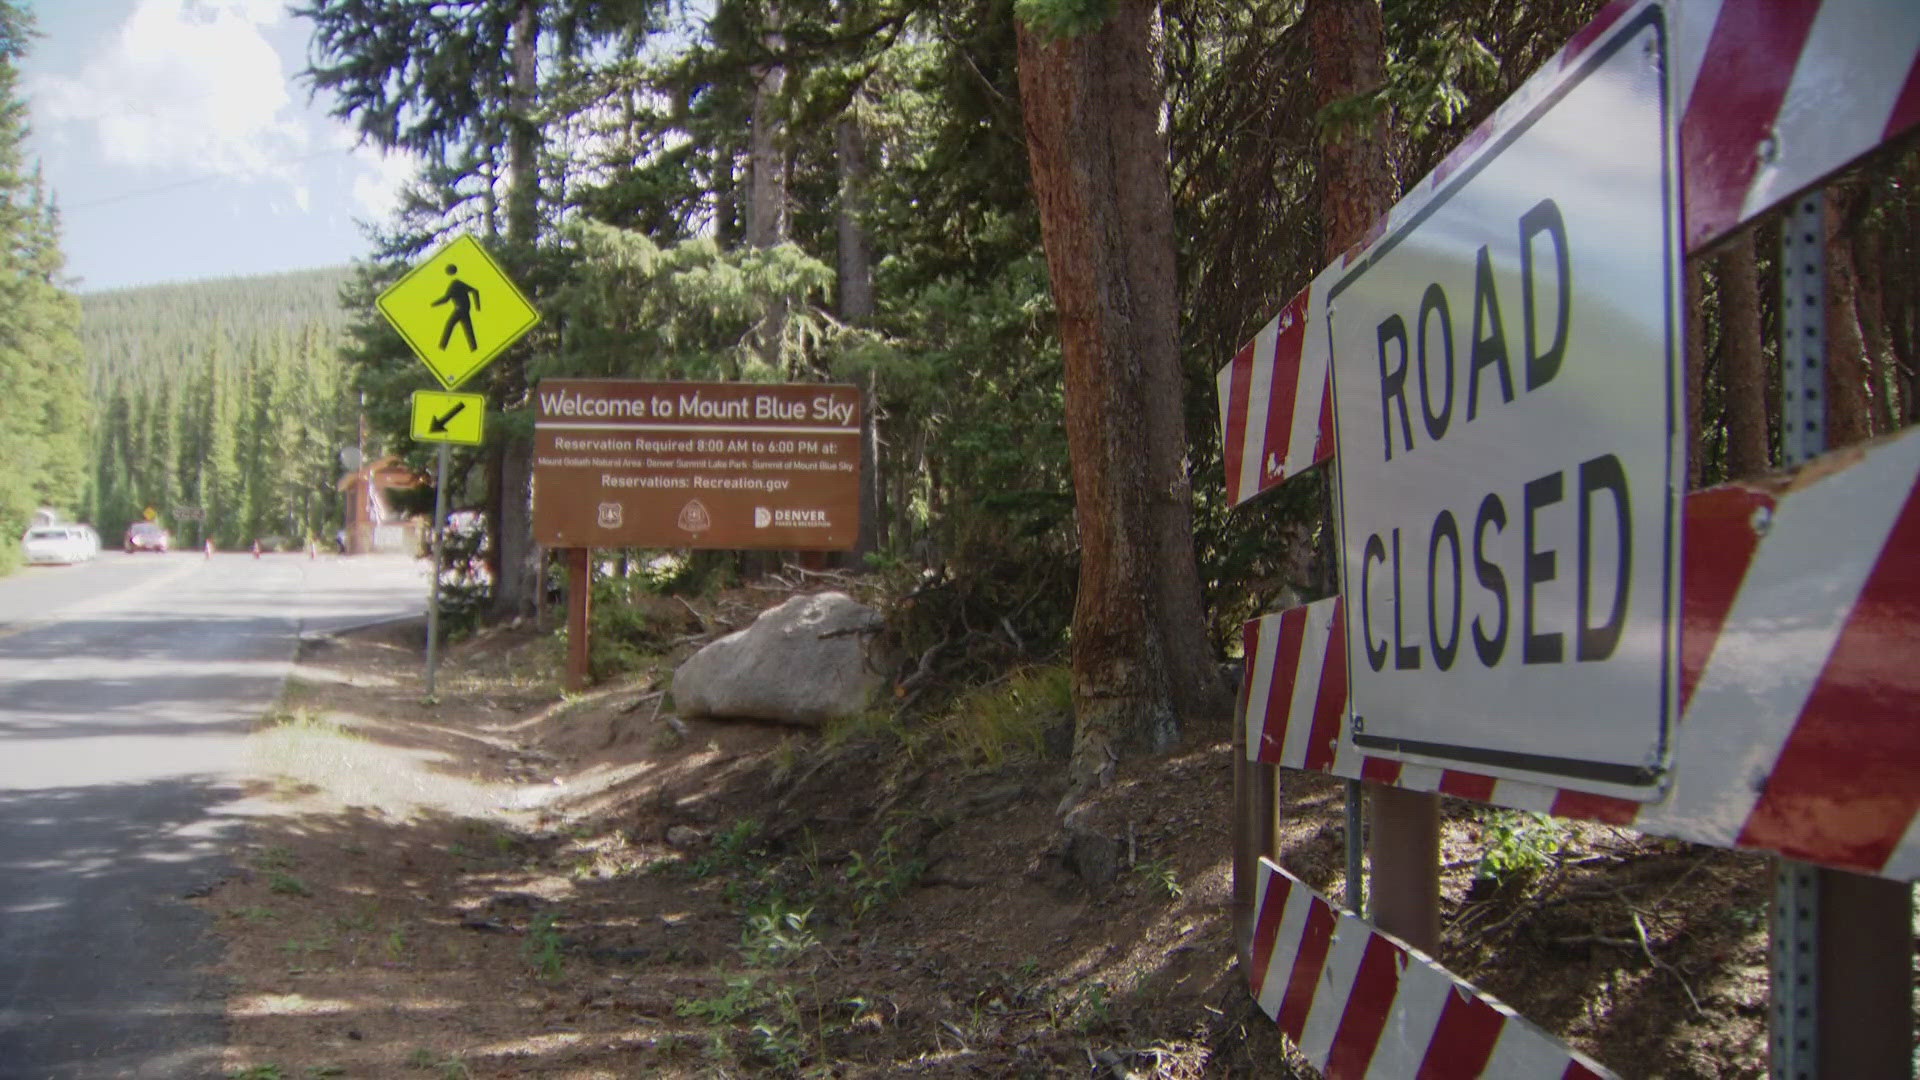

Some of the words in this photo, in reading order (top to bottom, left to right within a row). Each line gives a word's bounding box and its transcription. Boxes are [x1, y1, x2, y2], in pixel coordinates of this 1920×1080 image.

[1377, 198, 1571, 460] ROAD
[540, 390, 644, 417] Welcome
[652, 396, 671, 417] to
[680, 391, 748, 418] Mount
[756, 395, 805, 419] Blue
[812, 394, 854, 426] Sky
[555, 438, 631, 451] Reservation
[636, 439, 692, 453] Required
[697, 440, 723, 452] 8:00
[728, 441, 747, 453] AM
[752, 442, 764, 453] to
[768, 441, 793, 454] 6:00
[798, 442, 818, 454] PM
[822, 444, 837, 455] at:
[601, 475, 689, 488] Reservations:
[693, 476, 789, 492] Recreation.gov
[775, 510, 825, 521] DENVER
[1361, 454, 1632, 672] CLOSED
